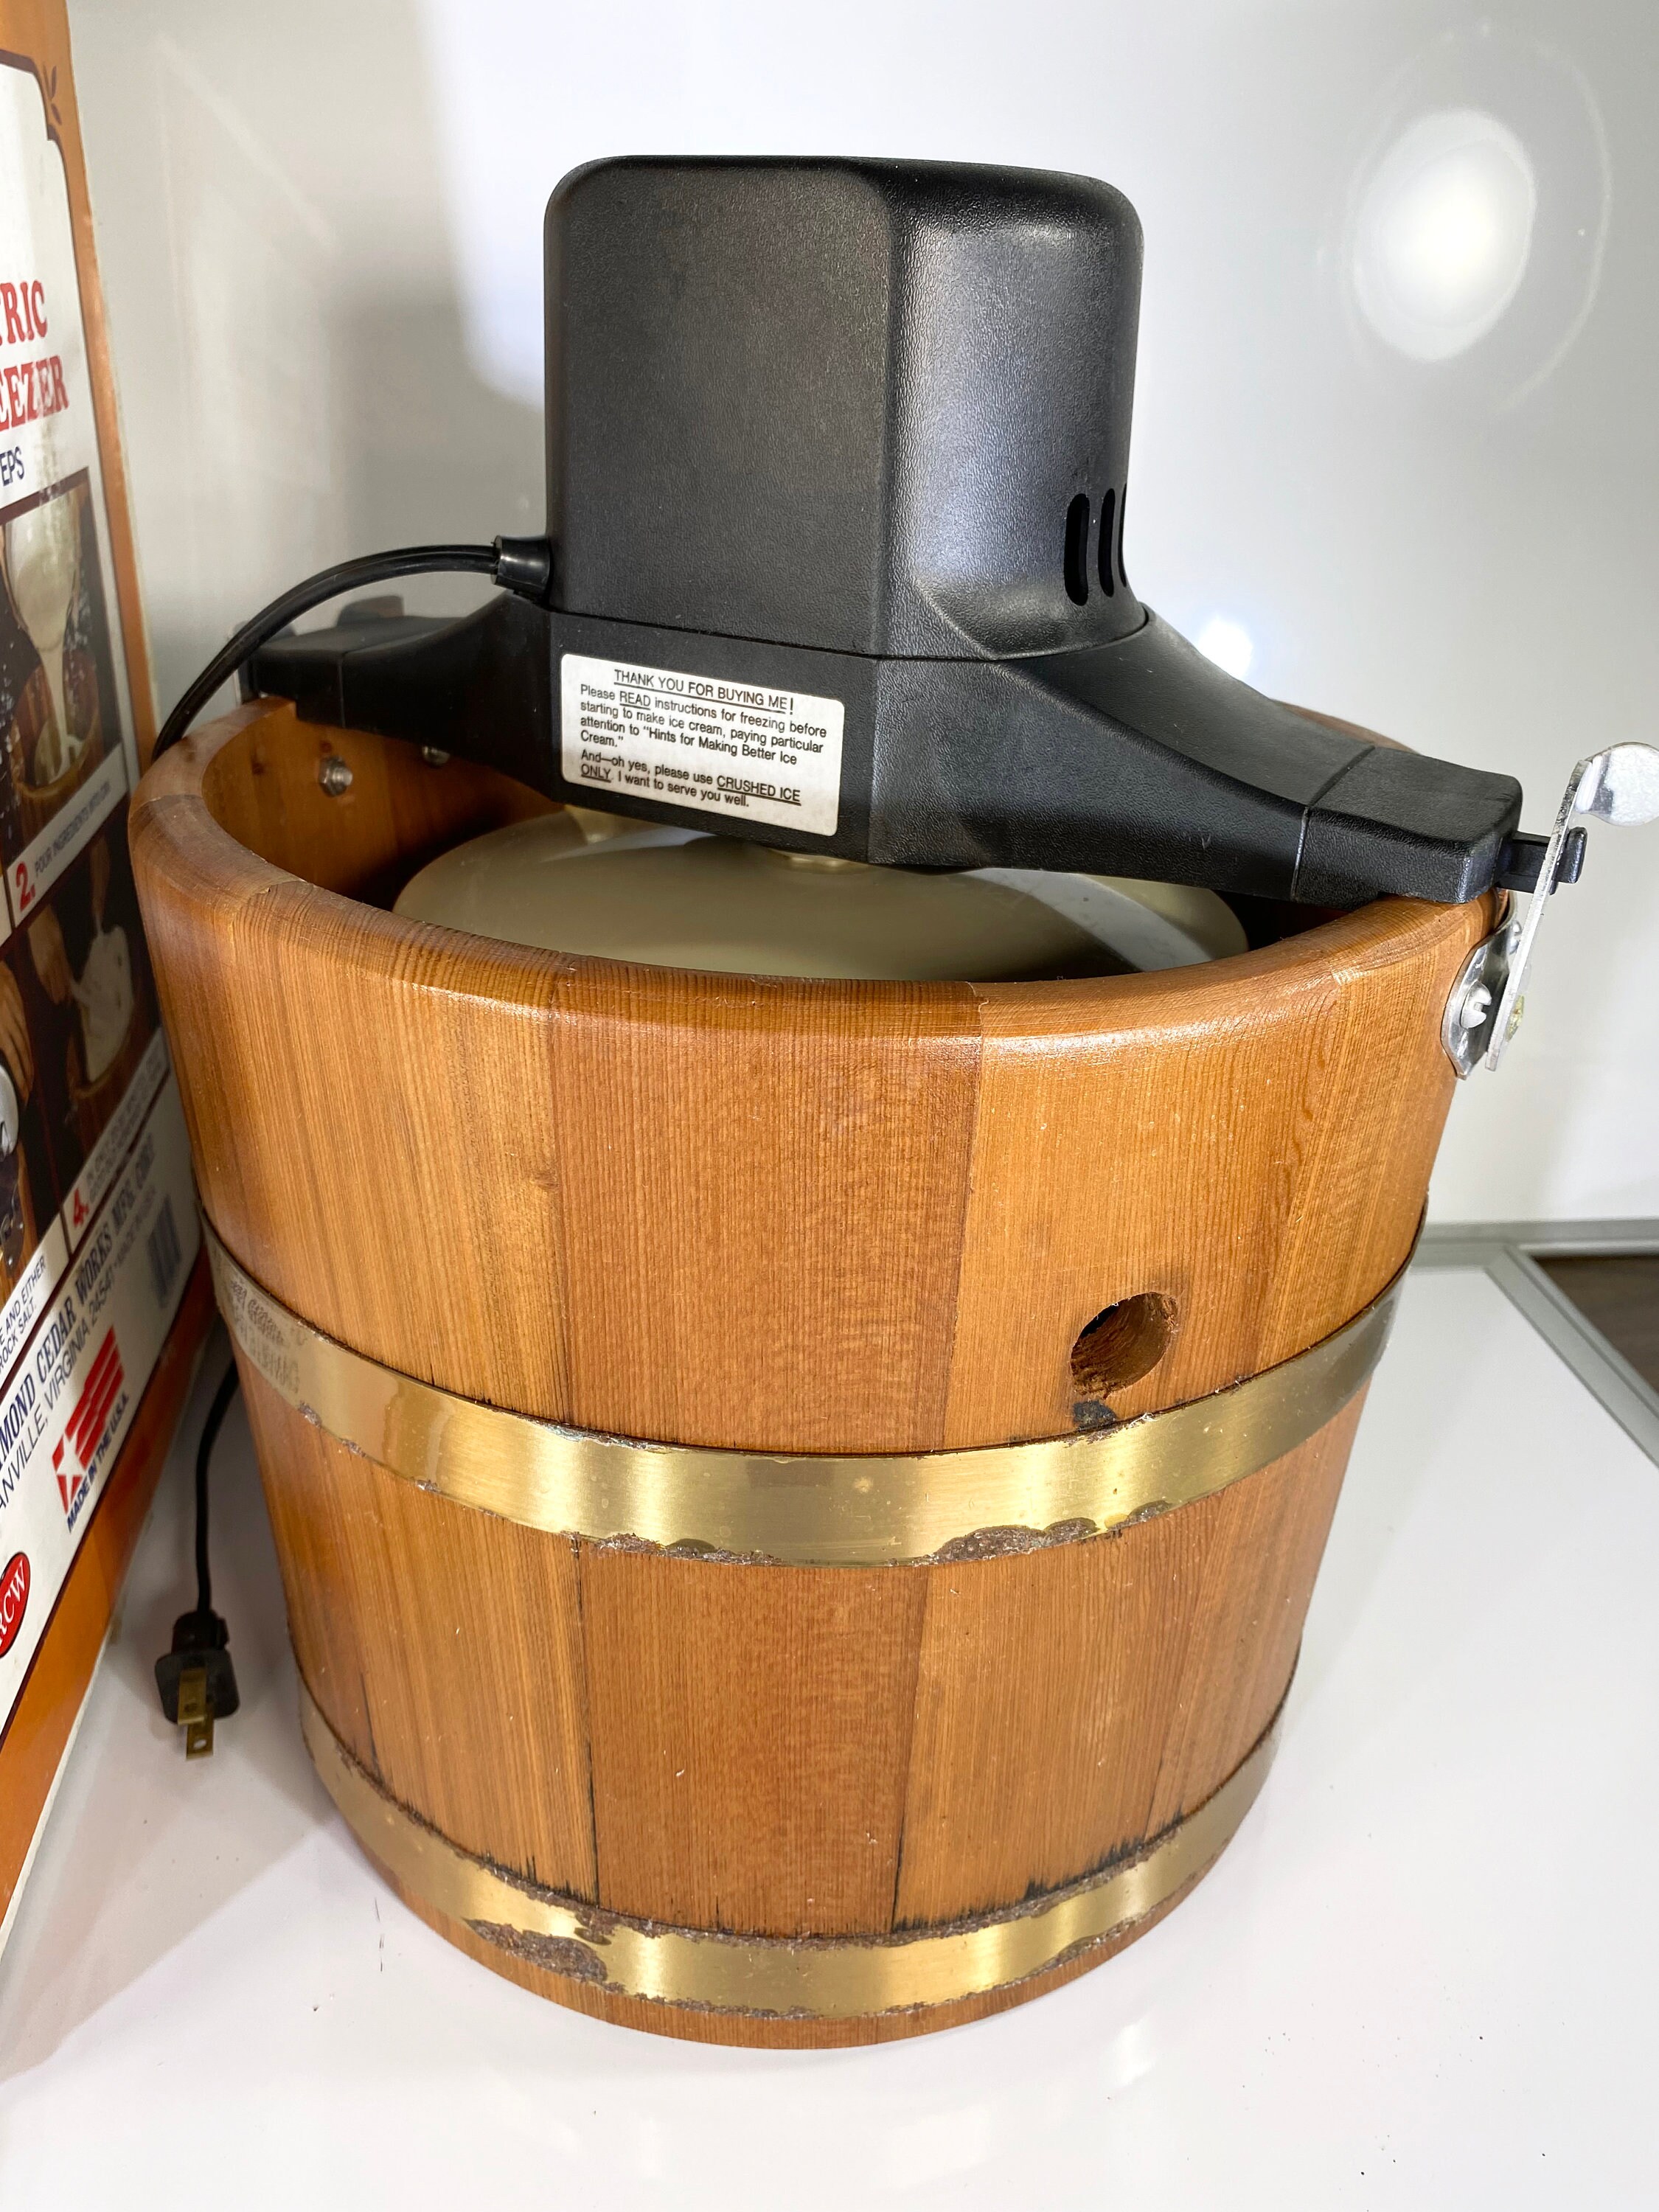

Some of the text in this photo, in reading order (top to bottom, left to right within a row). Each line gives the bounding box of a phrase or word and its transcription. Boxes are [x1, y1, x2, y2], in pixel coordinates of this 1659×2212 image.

[0, 279, 48, 346] RIC
[581, 684, 827, 738] Please READ instructions for freezing before
[614, 669, 654, 686] THANK
[658, 677, 684, 692] YOU
[689, 682, 713, 697] FOR
[717, 686, 764, 706] BUYING
[581, 701, 824, 753] starting to make ice cream, paying particular
[581, 730, 624, 748] Cream."
[581, 717, 797, 765] attention to "Hints for Making Better Ice
[618, 771, 622, 782] I
[625, 775, 650, 787] want
[654, 779, 664, 790] to
[667, 783, 697, 796] serve
[700, 788, 720, 801] you
[725, 793, 749, 807] well.
[628, 759, 650, 774] yes,
[655, 765, 689, 780] please
[693, 773, 713, 785] use
[717, 775, 776, 796] CRUSHED
[780, 787, 801, 802] ICE
[6, 1300, 21, 1335] AND
[21, 1255, 46, 1304] EITHER
[0, 1373, 35, 1472] MOND
[36, 1295, 77, 1384] CEDAR
[75, 1222, 113, 1306] WORKS
[44, 1317, 91, 1411] VIRGINIA
[67, 1475, 90, 1533] MADE
[88, 1457, 97, 1486] IN
[96, 1427, 111, 1464] THE
